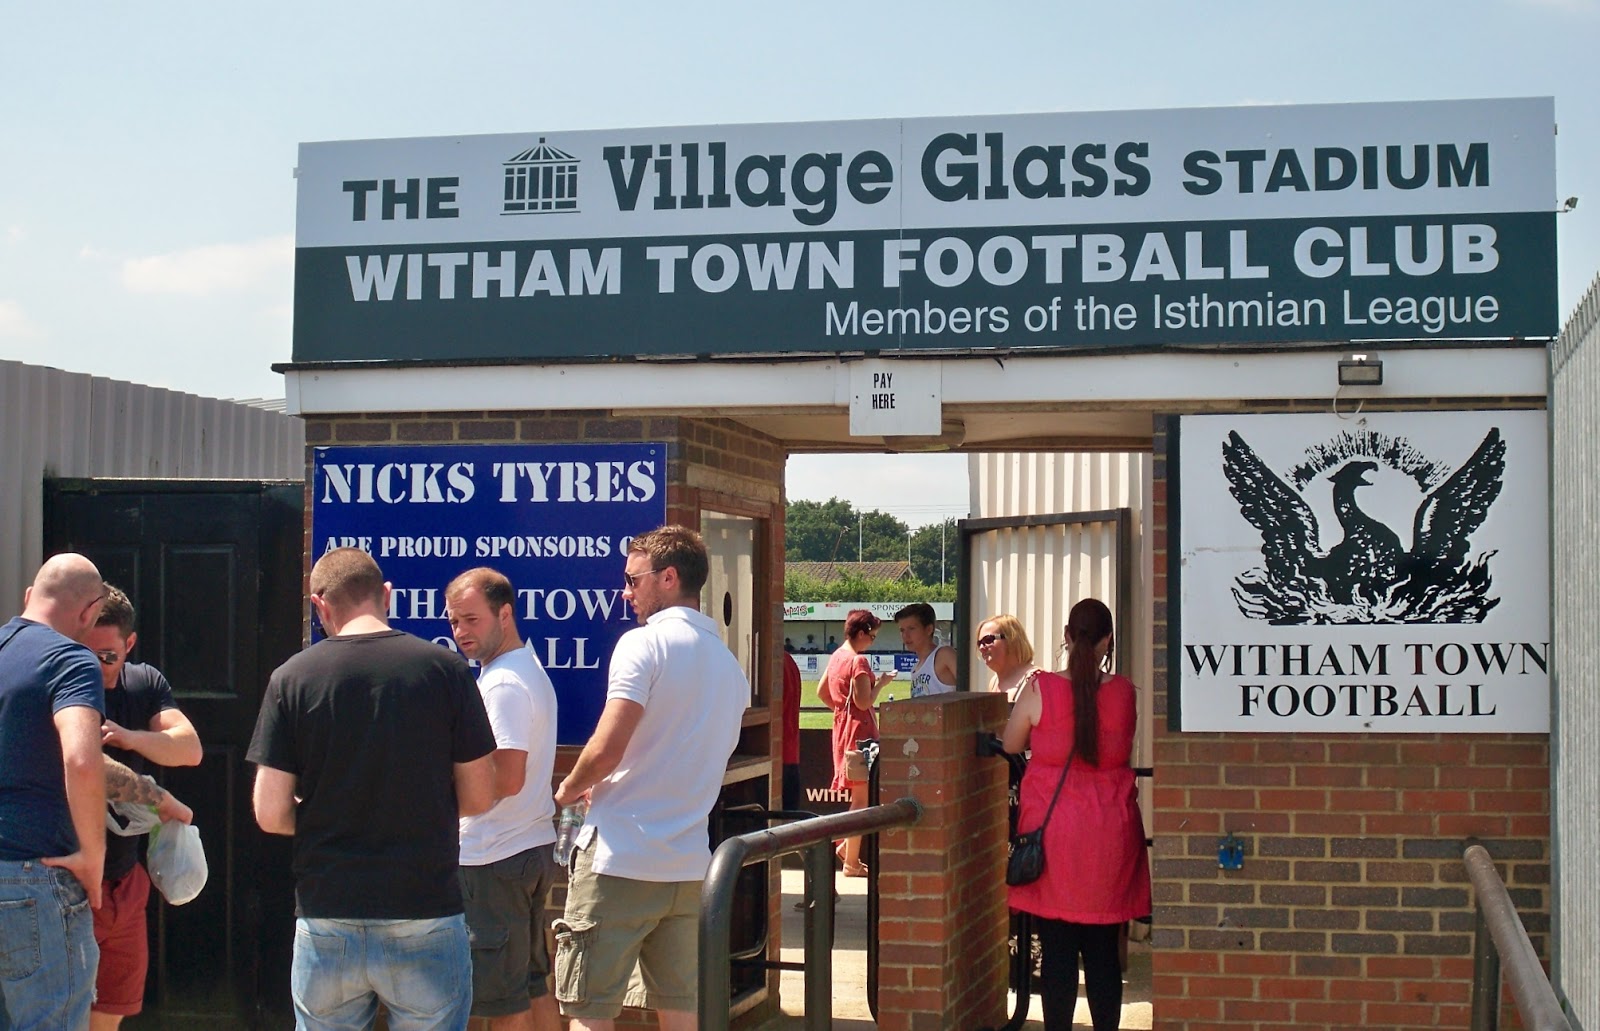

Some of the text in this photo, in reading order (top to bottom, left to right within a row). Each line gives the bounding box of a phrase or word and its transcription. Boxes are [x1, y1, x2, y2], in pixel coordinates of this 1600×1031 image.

[342, 132, 1490, 227] THE Village Glass STADIUM
[345, 222, 1500, 302] WITHAM TOWN FOOTBALL CLUB
[825, 289, 1499, 336] Members of the Isthmian League
[873, 372, 893, 389] PAY
[871, 393, 896, 410] HERE
[321, 460, 656, 504] NICKS TYRES
[380, 536, 468, 558] PROUD
[475, 535, 611, 558] SPONSORS
[517, 588, 631, 621] TOW
[1184, 642, 1549, 677] WITHAM TOWN
[1238, 684, 1497, 717] FOOTBALL
[806, 788, 852, 803] WITH
